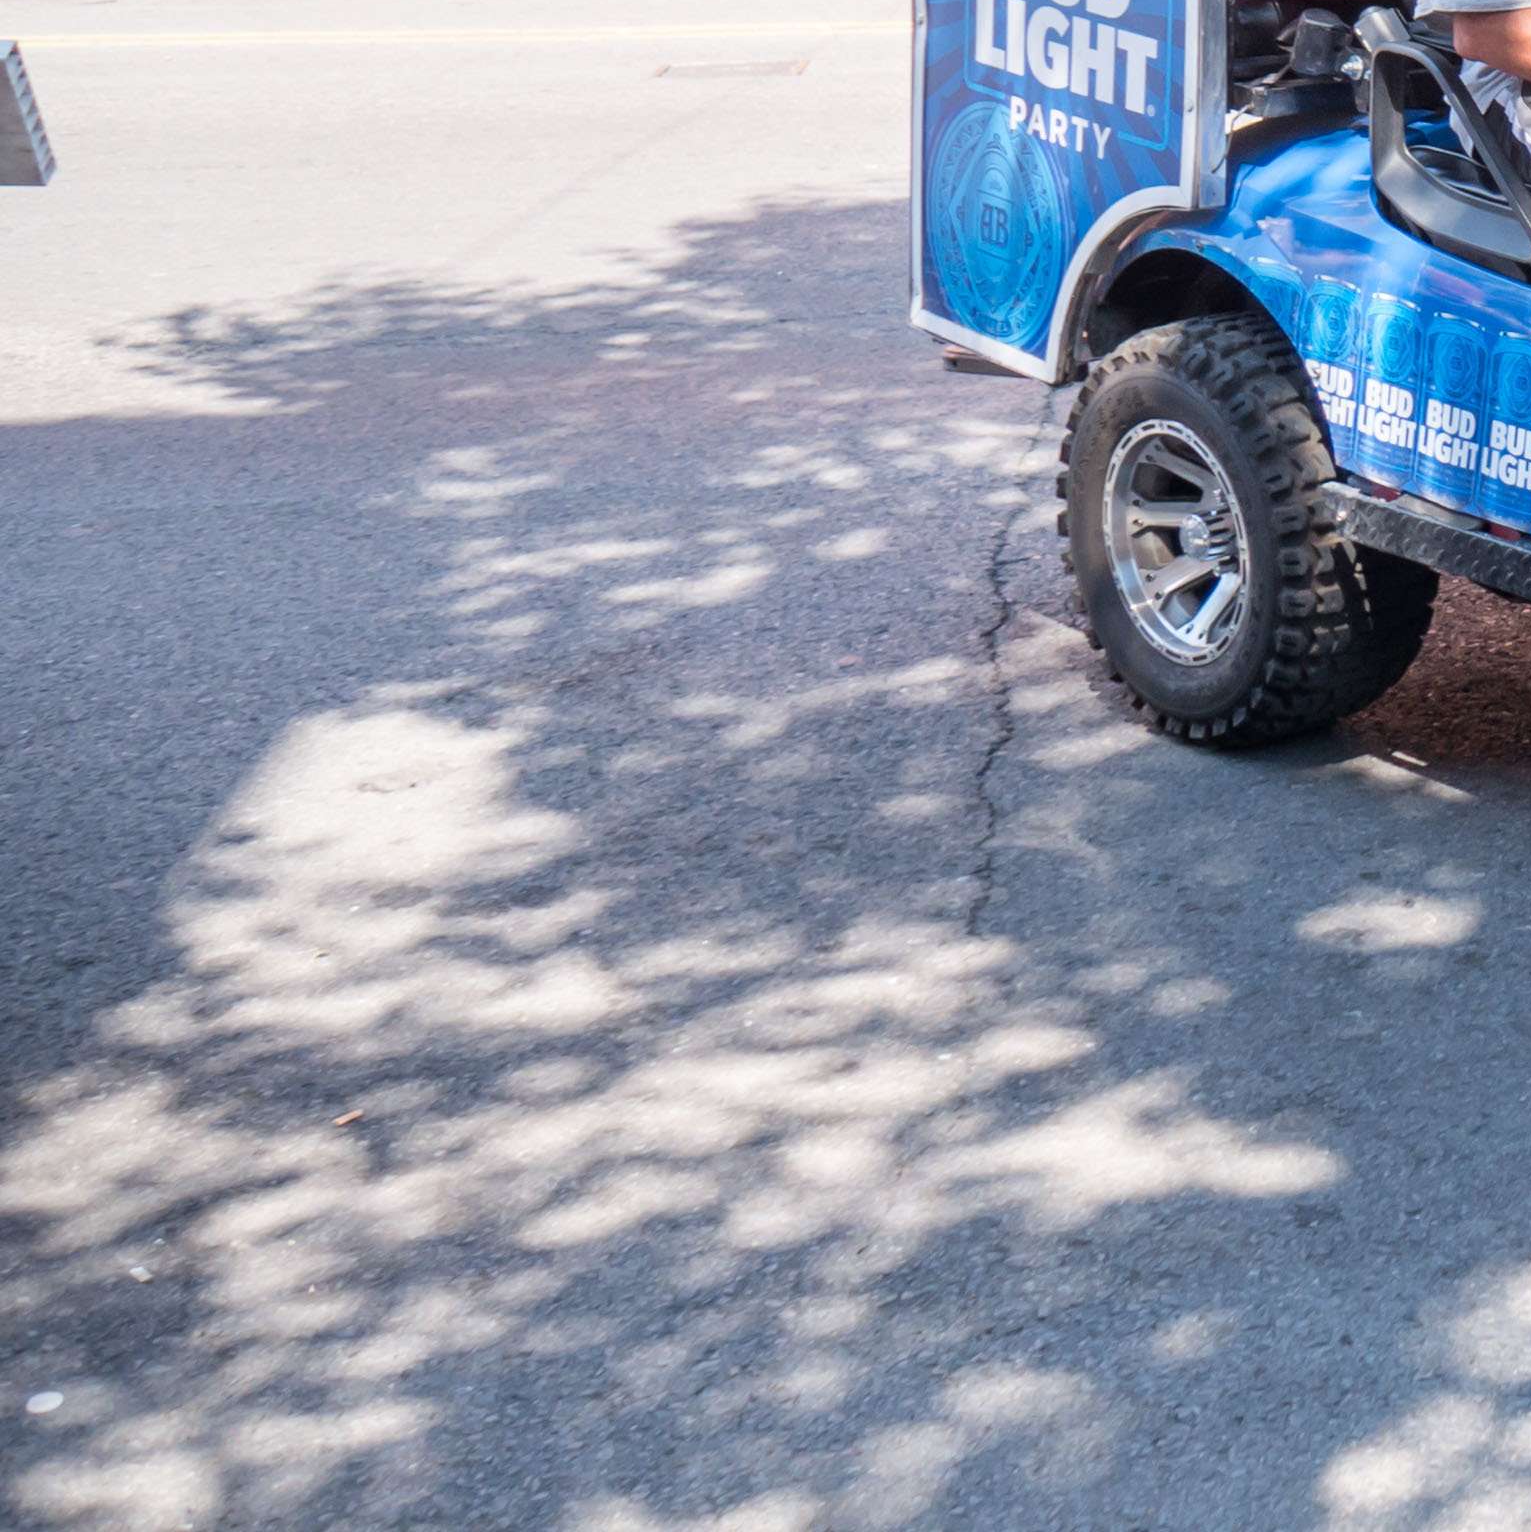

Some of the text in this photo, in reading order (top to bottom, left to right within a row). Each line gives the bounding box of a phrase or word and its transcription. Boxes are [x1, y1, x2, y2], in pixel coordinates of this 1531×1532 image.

[1009, 95, 1111, 160] PARTY
[1364, 378, 1415, 419] BUD
[1426, 398, 1477, 440] BUD
[1357, 404, 1417, 449] LIGHT
[1418, 425, 1478, 469] LIGHT
